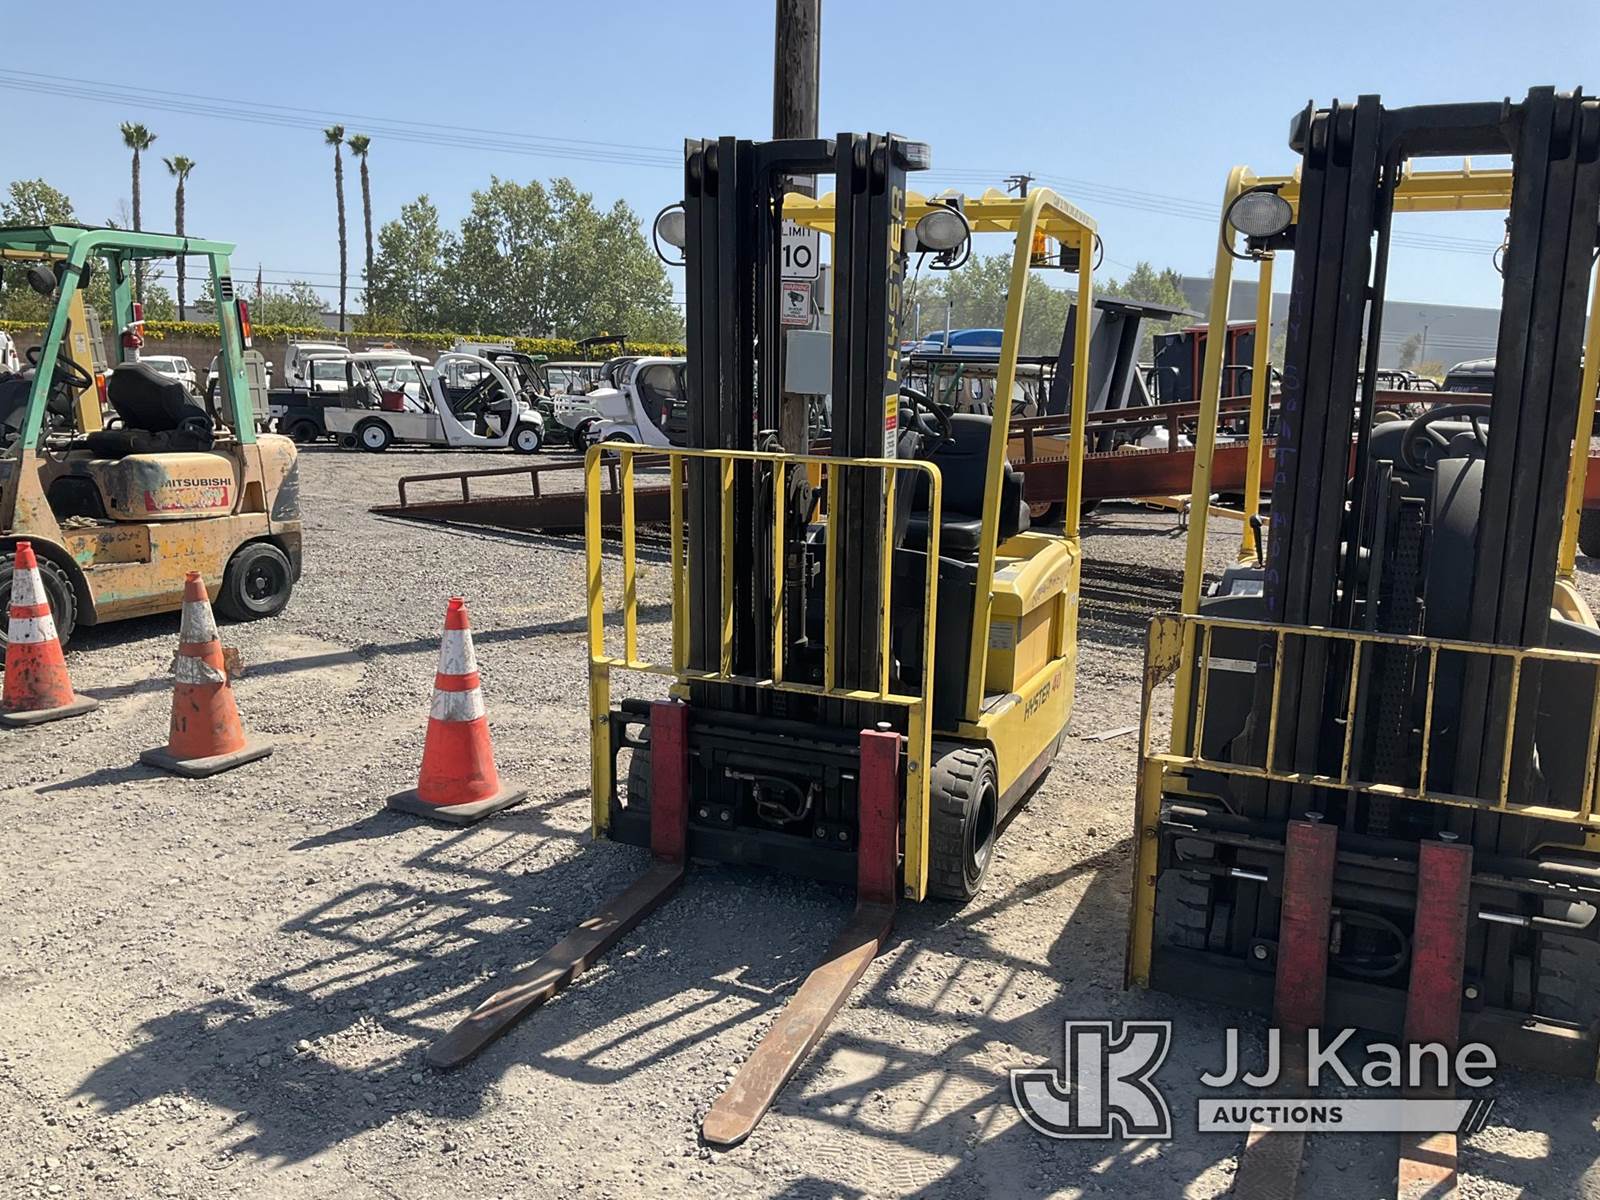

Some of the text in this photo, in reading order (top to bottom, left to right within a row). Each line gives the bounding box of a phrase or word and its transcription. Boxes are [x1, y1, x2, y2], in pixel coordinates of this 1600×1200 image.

[783, 245, 811, 268] 10
[887, 185, 902, 382] HYSTER
[161, 478, 231, 487] MITSUBISHI
[1023, 680, 1051, 722] HYSTER
